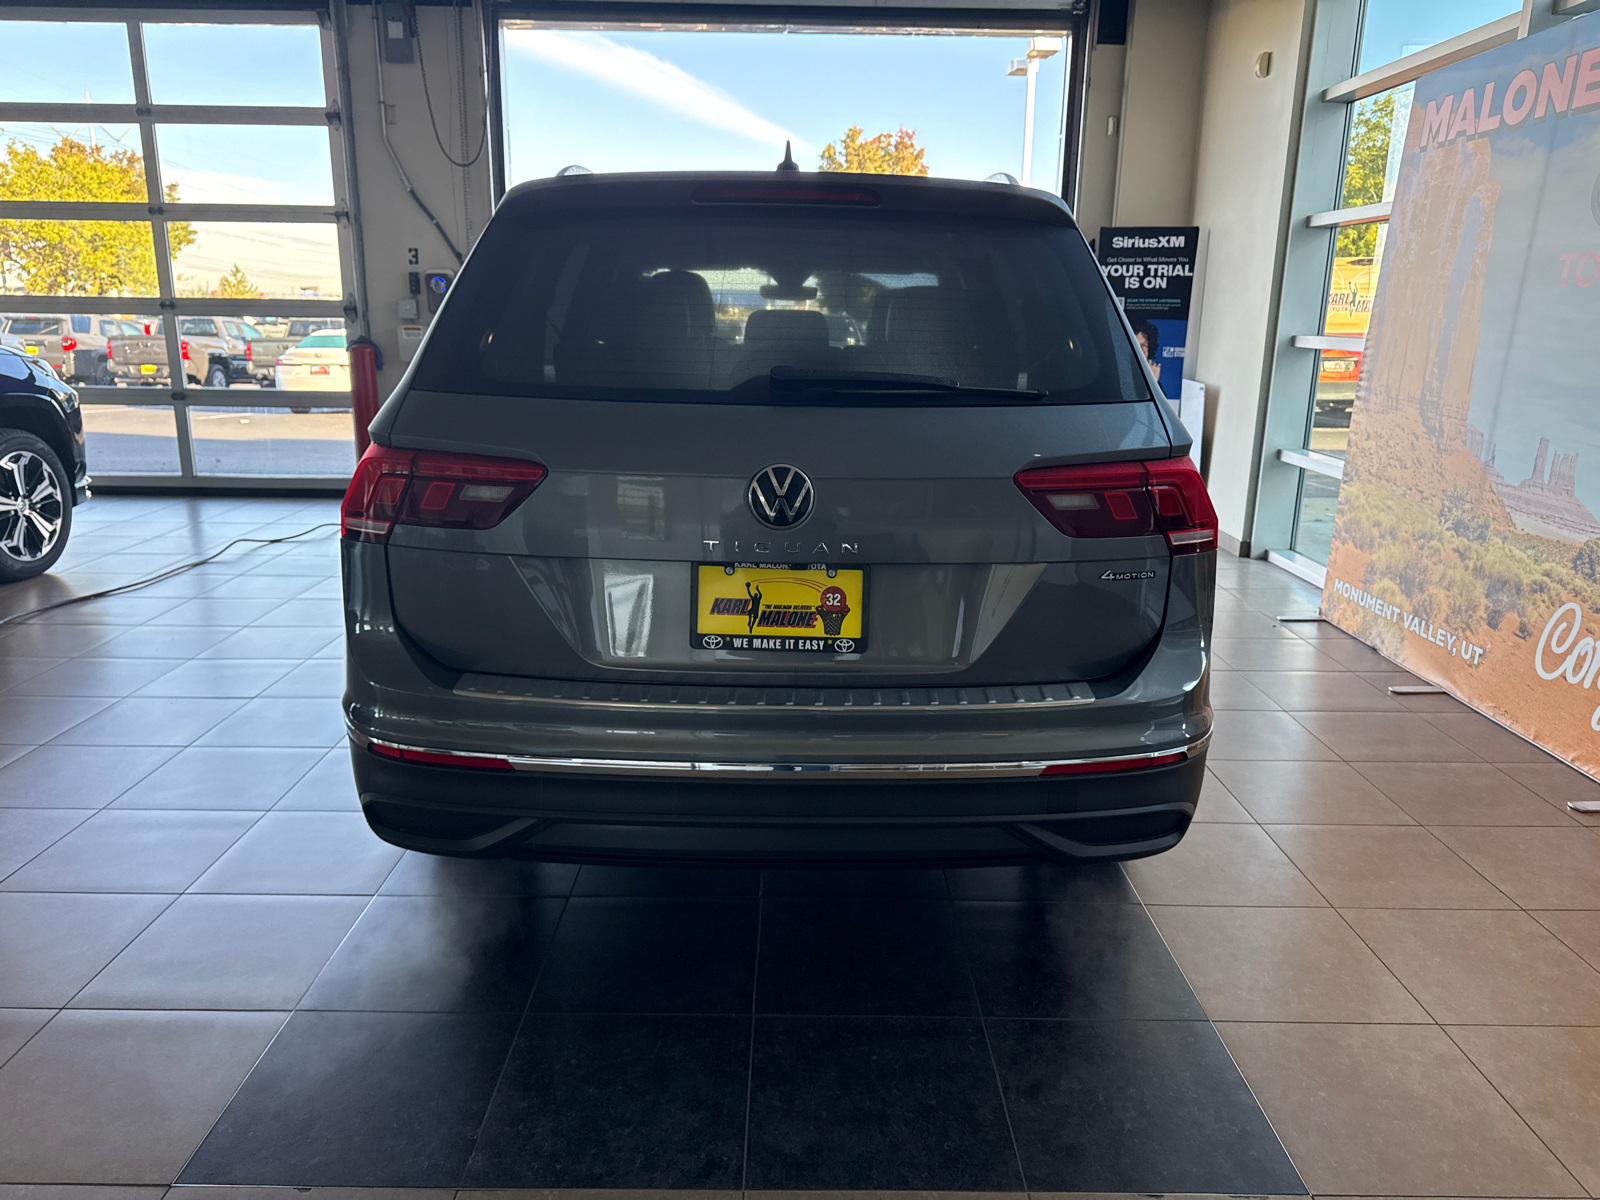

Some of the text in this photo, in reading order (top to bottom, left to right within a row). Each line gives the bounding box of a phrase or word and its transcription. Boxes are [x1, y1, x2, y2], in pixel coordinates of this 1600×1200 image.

[1419, 47, 1600, 152] MALONE
[1112, 236, 1185, 248] SiriusXM
[408, 247, 419, 265] 3
[1101, 264, 1193, 277] YOUR TRIAL
[1124, 277, 1167, 289] IS ON
[703, 540, 859, 554] TIGUAN
[1100, 570, 1155, 581] 4MOTION
[825, 593, 841, 606] 32
[710, 598, 752, 615] KARL
[757, 610, 818, 628] MALONE
[1333, 578, 1484, 666] MONUMENT VALLEY, UT
[733, 638, 825, 650] WE MAKE IT EASY
